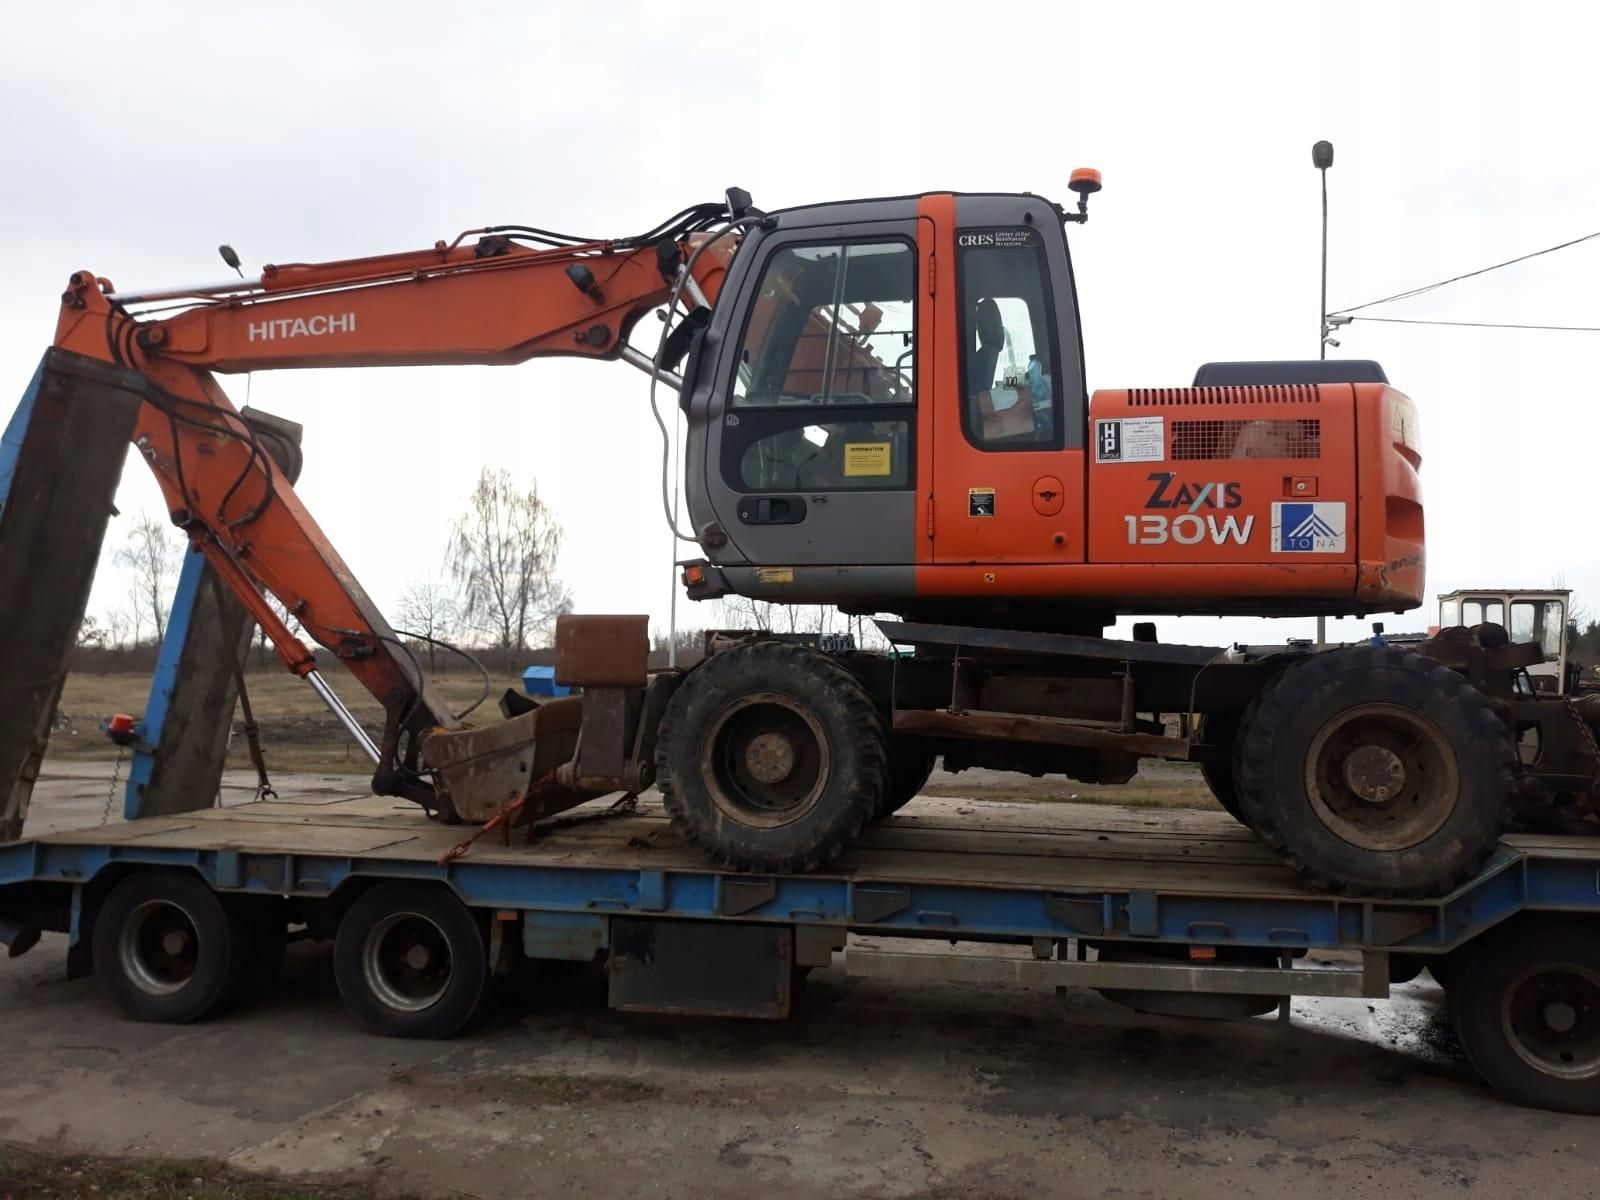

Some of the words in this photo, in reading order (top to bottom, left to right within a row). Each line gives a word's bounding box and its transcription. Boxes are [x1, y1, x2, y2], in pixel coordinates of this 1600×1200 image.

[958, 234, 994, 247] CRES
[248, 312, 356, 342] HITACHI
[1144, 472, 1243, 512] ZAXIS
[1124, 514, 1257, 545] 130W
[1289, 537, 1337, 550] TONA
